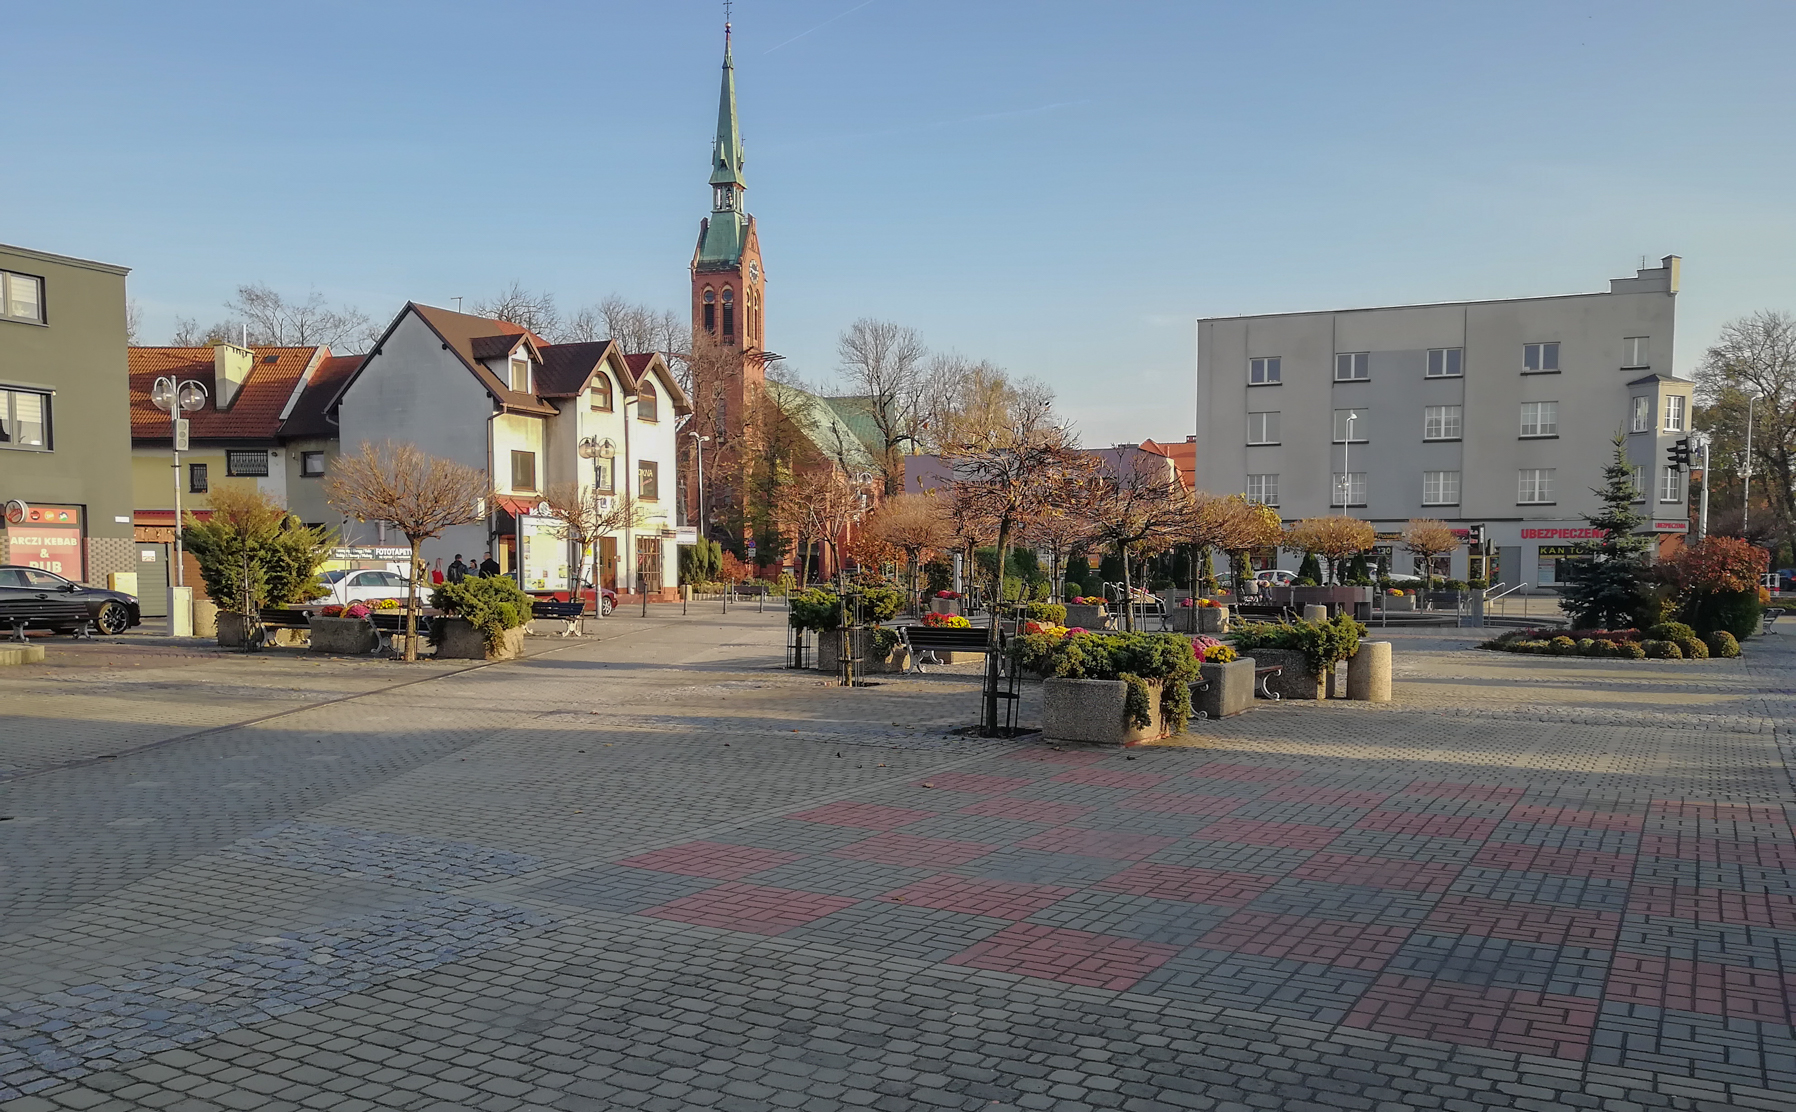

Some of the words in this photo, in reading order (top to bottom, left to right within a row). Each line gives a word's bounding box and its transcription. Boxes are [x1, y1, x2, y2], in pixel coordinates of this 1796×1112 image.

[10, 537, 42, 545] ARCZI
[44, 537, 77, 546] KEBAB
[40, 548, 49, 558] &
[29, 561, 62, 573] PUB
